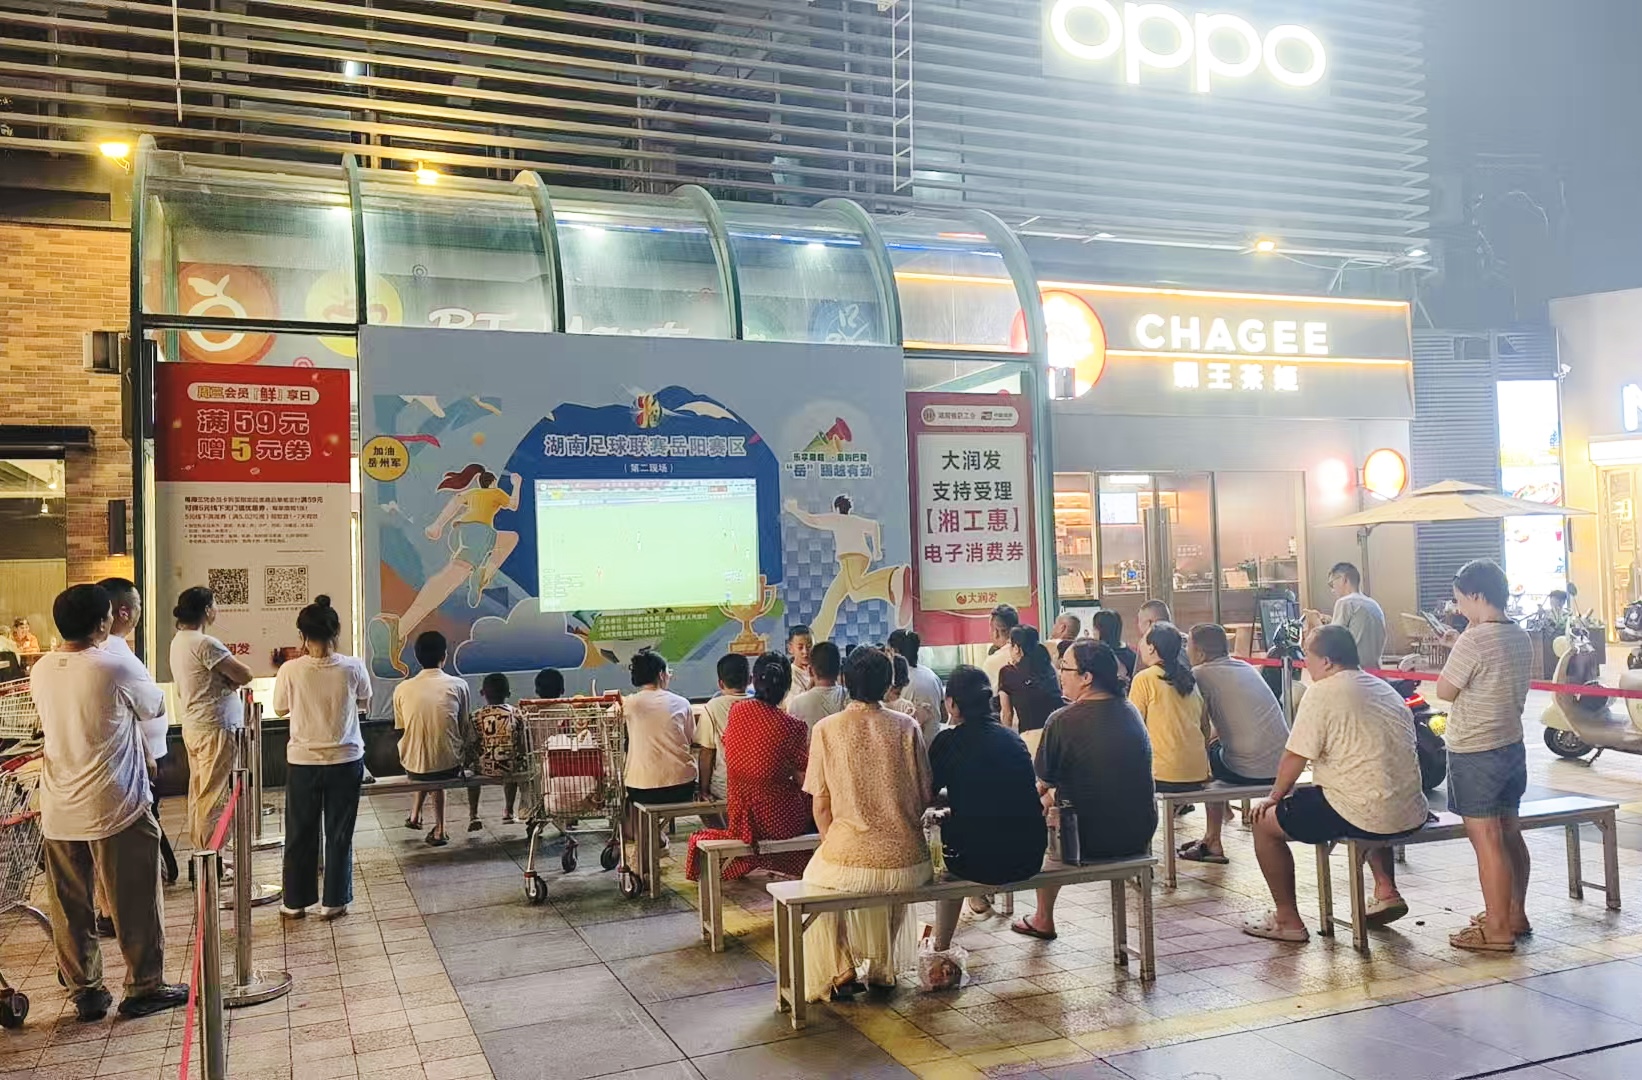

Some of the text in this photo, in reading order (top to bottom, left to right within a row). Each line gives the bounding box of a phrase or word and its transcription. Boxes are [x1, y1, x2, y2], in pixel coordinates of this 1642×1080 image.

[1135, 314, 1330, 355] CHAGEE
[196, 408, 310, 434] 满59元
[197, 437, 312, 462] 赠5元券
[373, 446, 395, 456] 加油
[543, 434, 748, 458] 湖南足球联赛岳阳赛区
[368, 457, 402, 468] 岳州军
[941, 450, 1001, 471] 大润发
[932, 481, 1013, 502] 支持受理
[925, 508, 1022, 534] 【湘工惠】
[924, 542, 1024, 563] 电子消费券
[967, 591, 998, 604] 大润发
[224, 642, 250, 656] 润发
